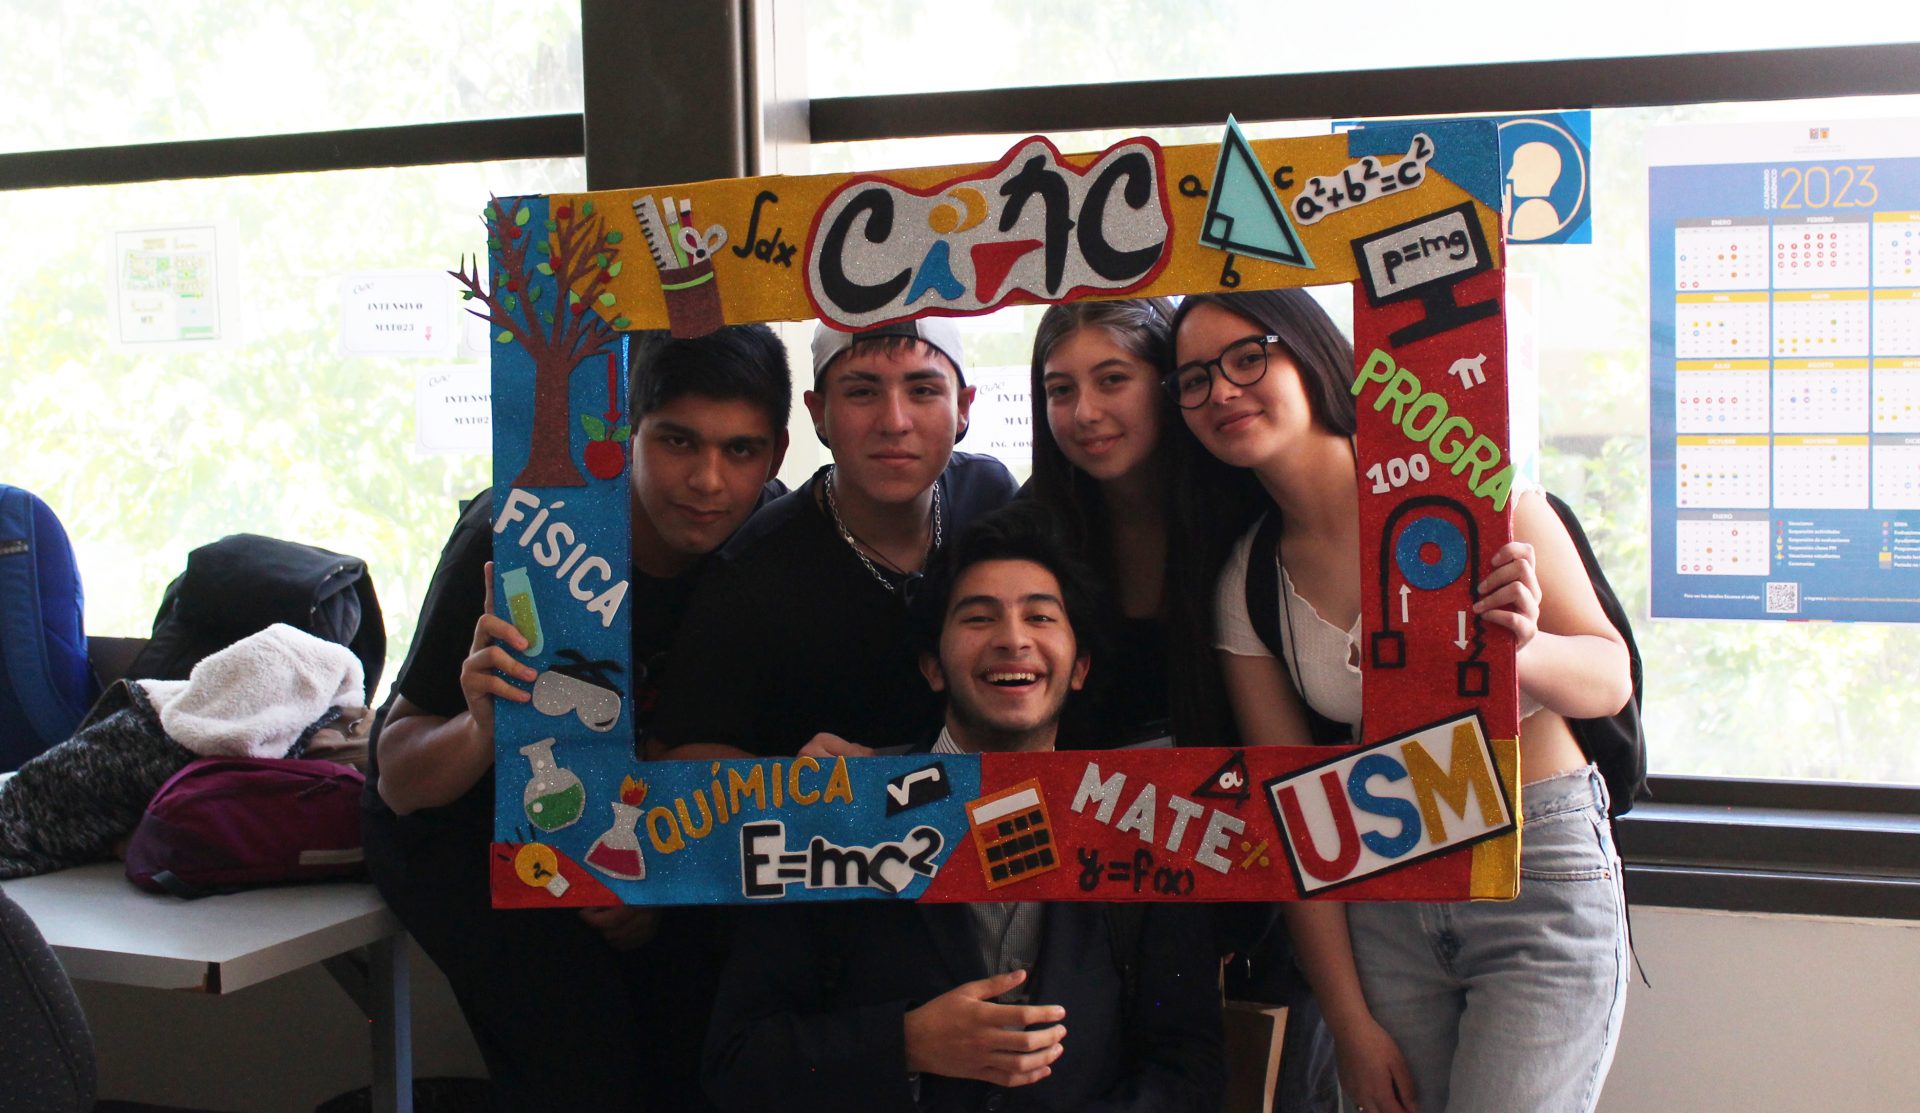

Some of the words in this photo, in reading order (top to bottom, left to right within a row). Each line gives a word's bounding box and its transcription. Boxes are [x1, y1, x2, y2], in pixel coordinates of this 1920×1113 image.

[1780, 165, 1879, 209] 2023
[368, 302, 423, 311] INTENSIVO
[997, 394, 1031, 402] INTE
[1350, 348, 1517, 512] PROGRA
[1366, 453, 1430, 494] 100
[493, 488, 629, 628] FÍSICA
[645, 756, 854, 855] QUÍMICA
[1071, 761, 1246, 875] MATE
[1276, 722, 1504, 883] USM
